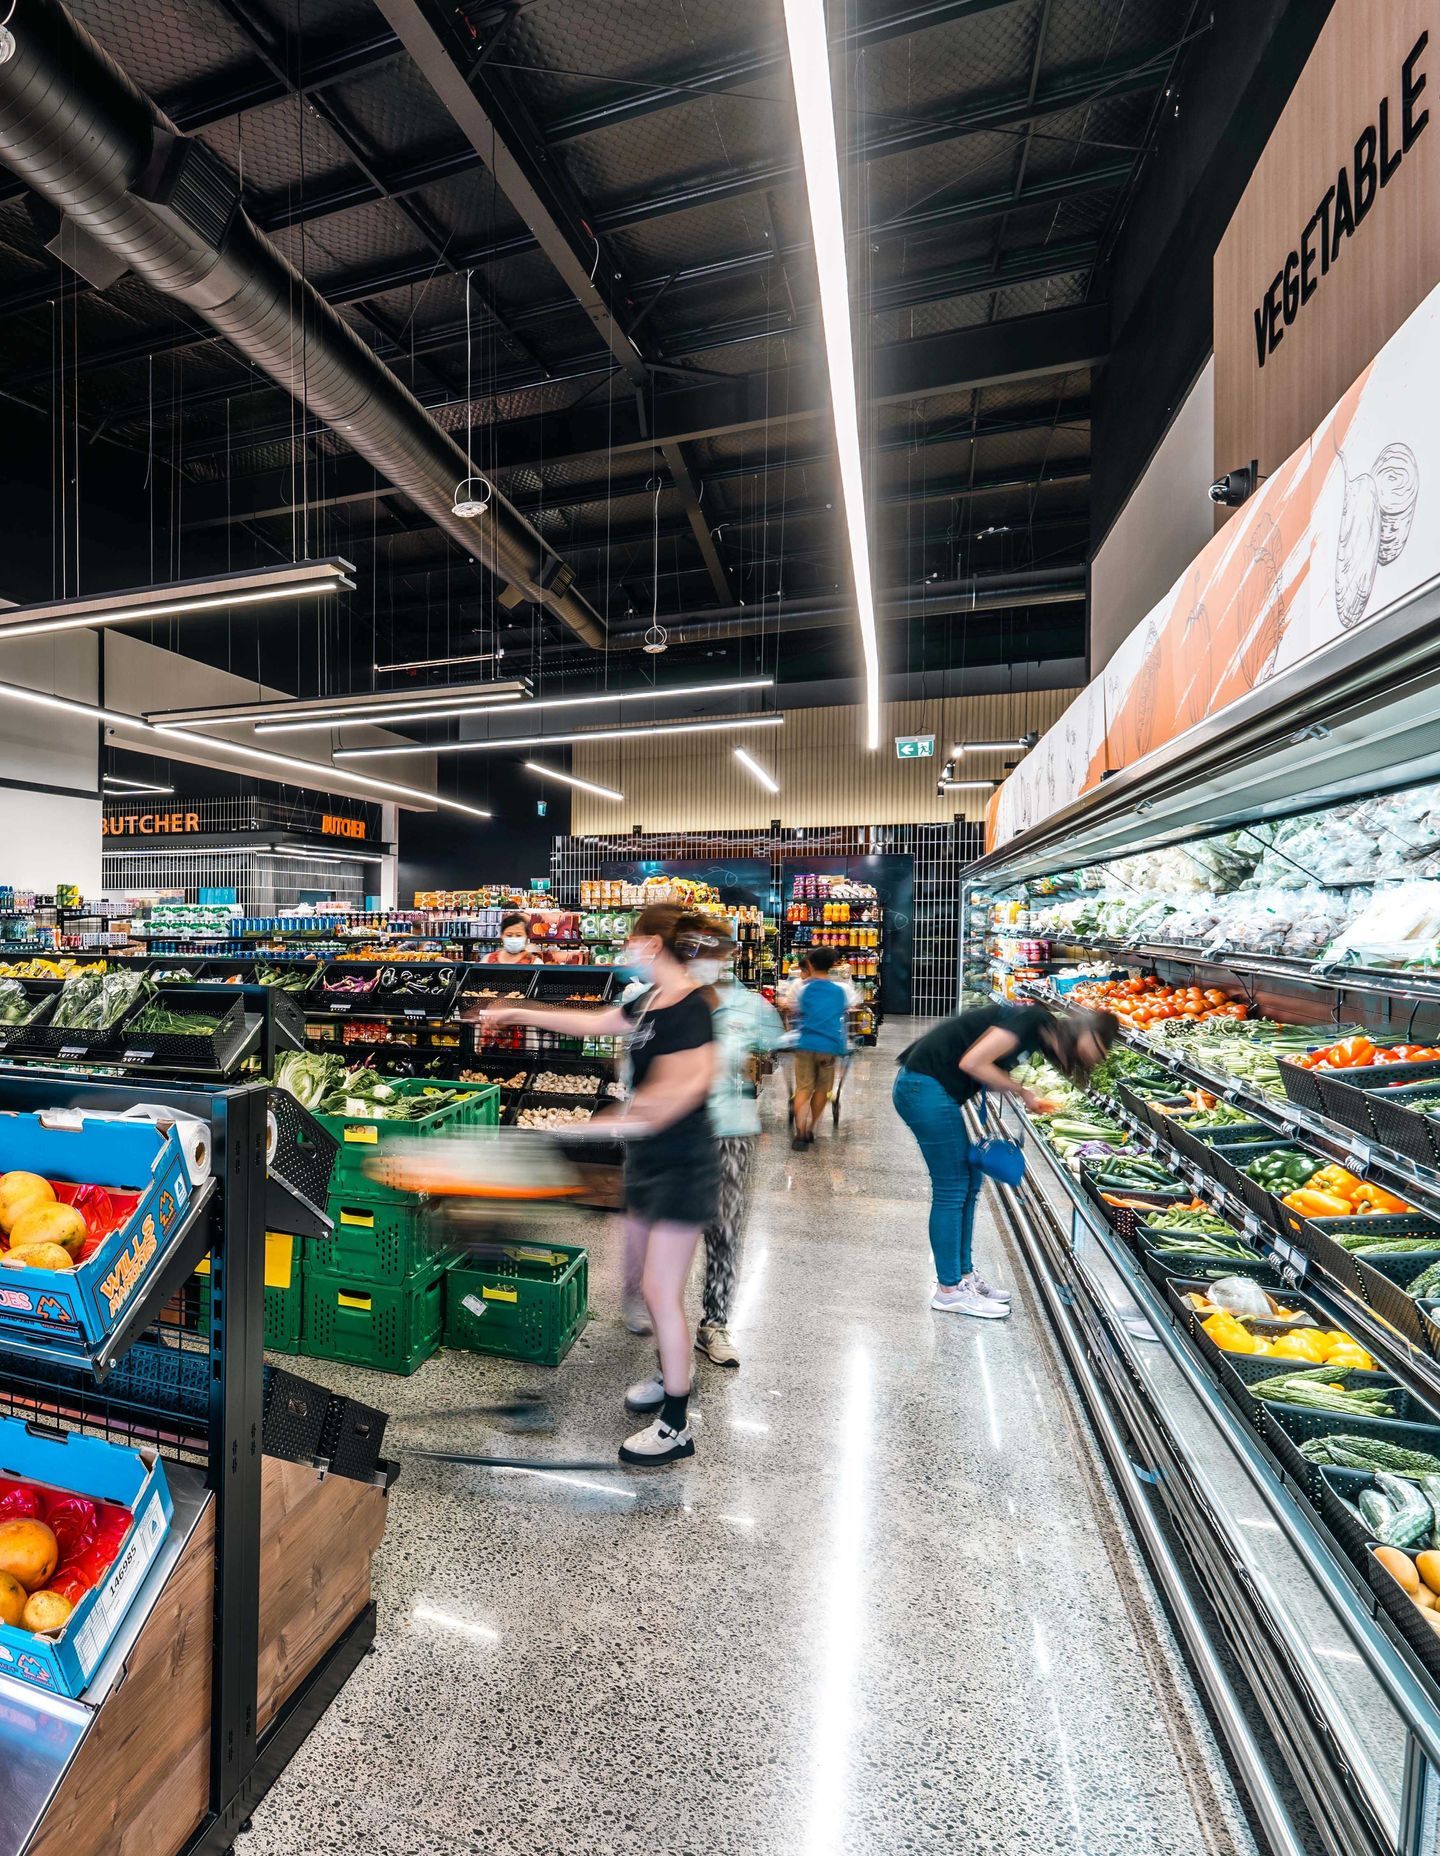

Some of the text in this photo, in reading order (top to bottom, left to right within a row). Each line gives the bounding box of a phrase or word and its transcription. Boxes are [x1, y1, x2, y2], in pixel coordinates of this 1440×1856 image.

[1254, 30, 1429, 368] VEGETABLE
[321, 814, 366, 839] BUTCHER
[99, 1213, 155, 1299] WILLS
[109, 1543, 137, 1597] 146985
